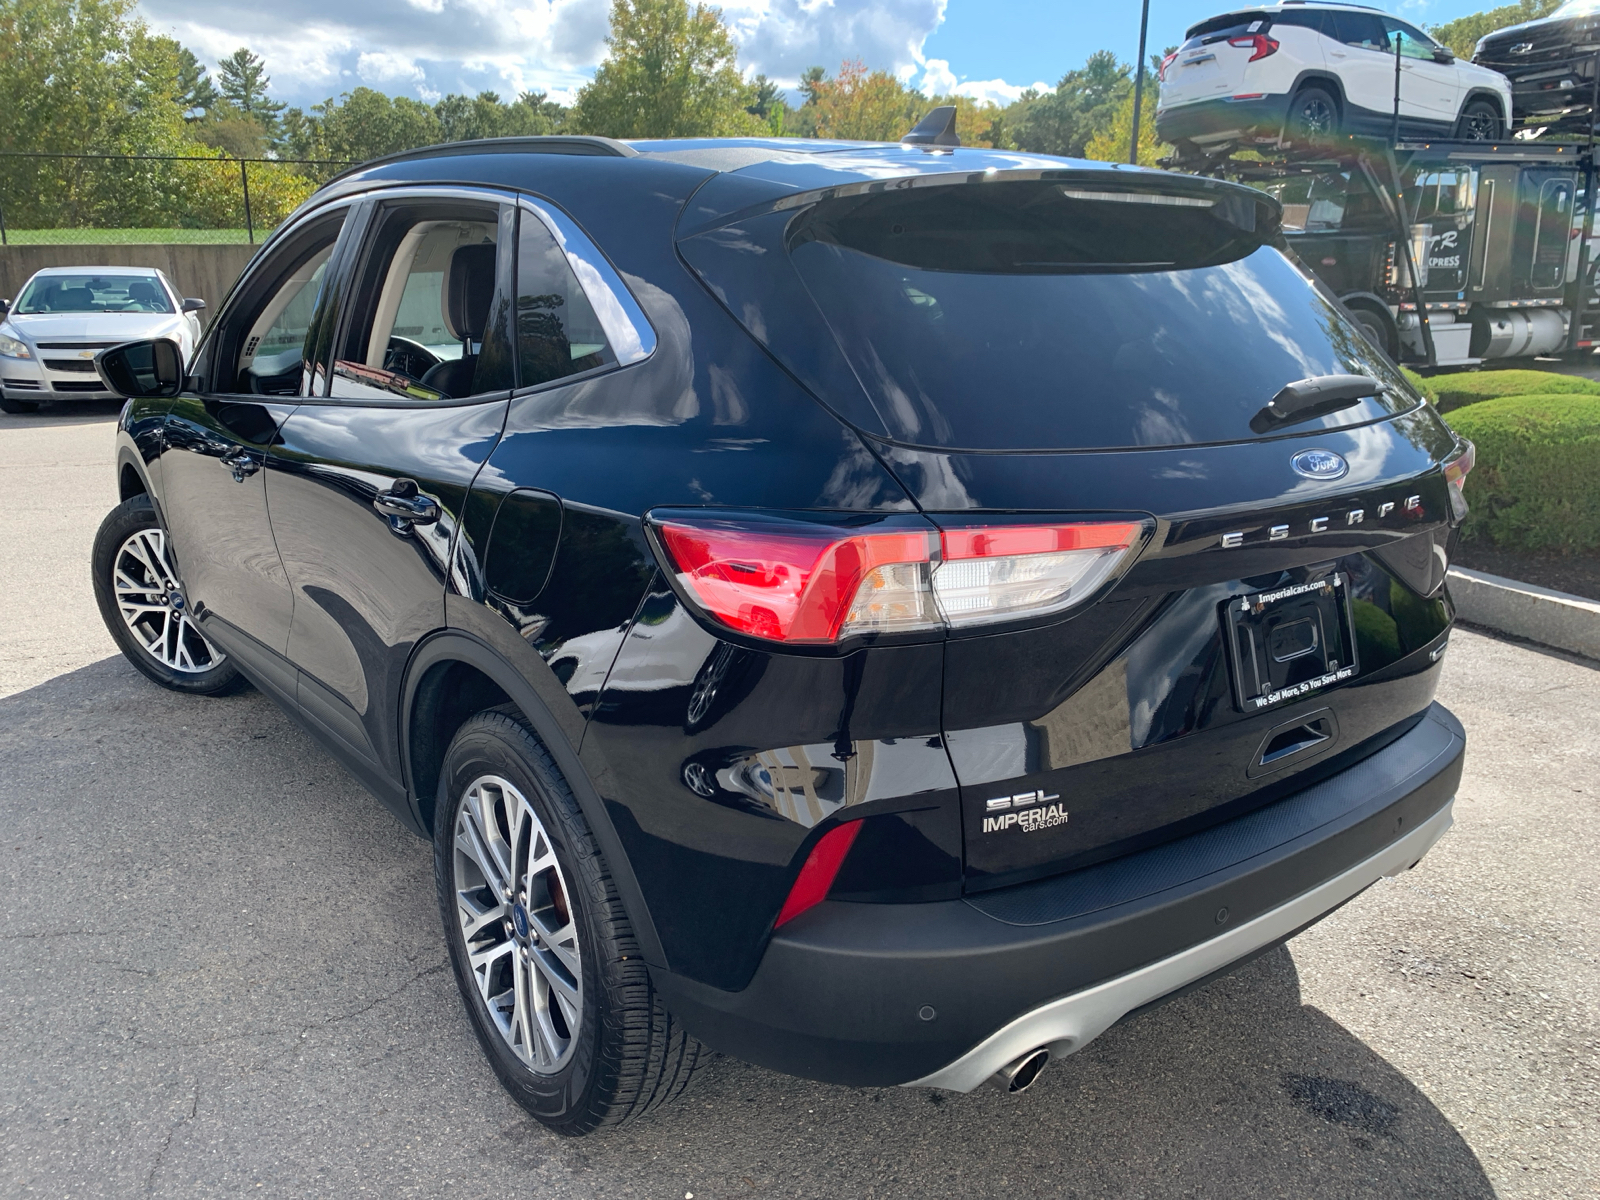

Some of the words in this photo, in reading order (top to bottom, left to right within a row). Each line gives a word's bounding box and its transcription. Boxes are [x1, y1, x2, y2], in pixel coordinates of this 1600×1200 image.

[1307, 453, 1339, 472] Ford
[1220, 495, 1420, 548] ESCAPE
[1258, 580, 1326, 603] Imperialcars.com
[1255, 697, 1268, 708] We
[1267, 693, 1281, 704] Sell
[1281, 687, 1300, 699] More,
[1300, 683, 1310, 693] So
[1309, 679, 1322, 690] You
[1321, 674, 1337, 685] Save
[1336, 668, 1352, 679] More
[986, 789, 1060, 812] SEL
[983, 803, 1068, 833] IMPERIAL
[1022, 815, 1068, 833] cars.com
